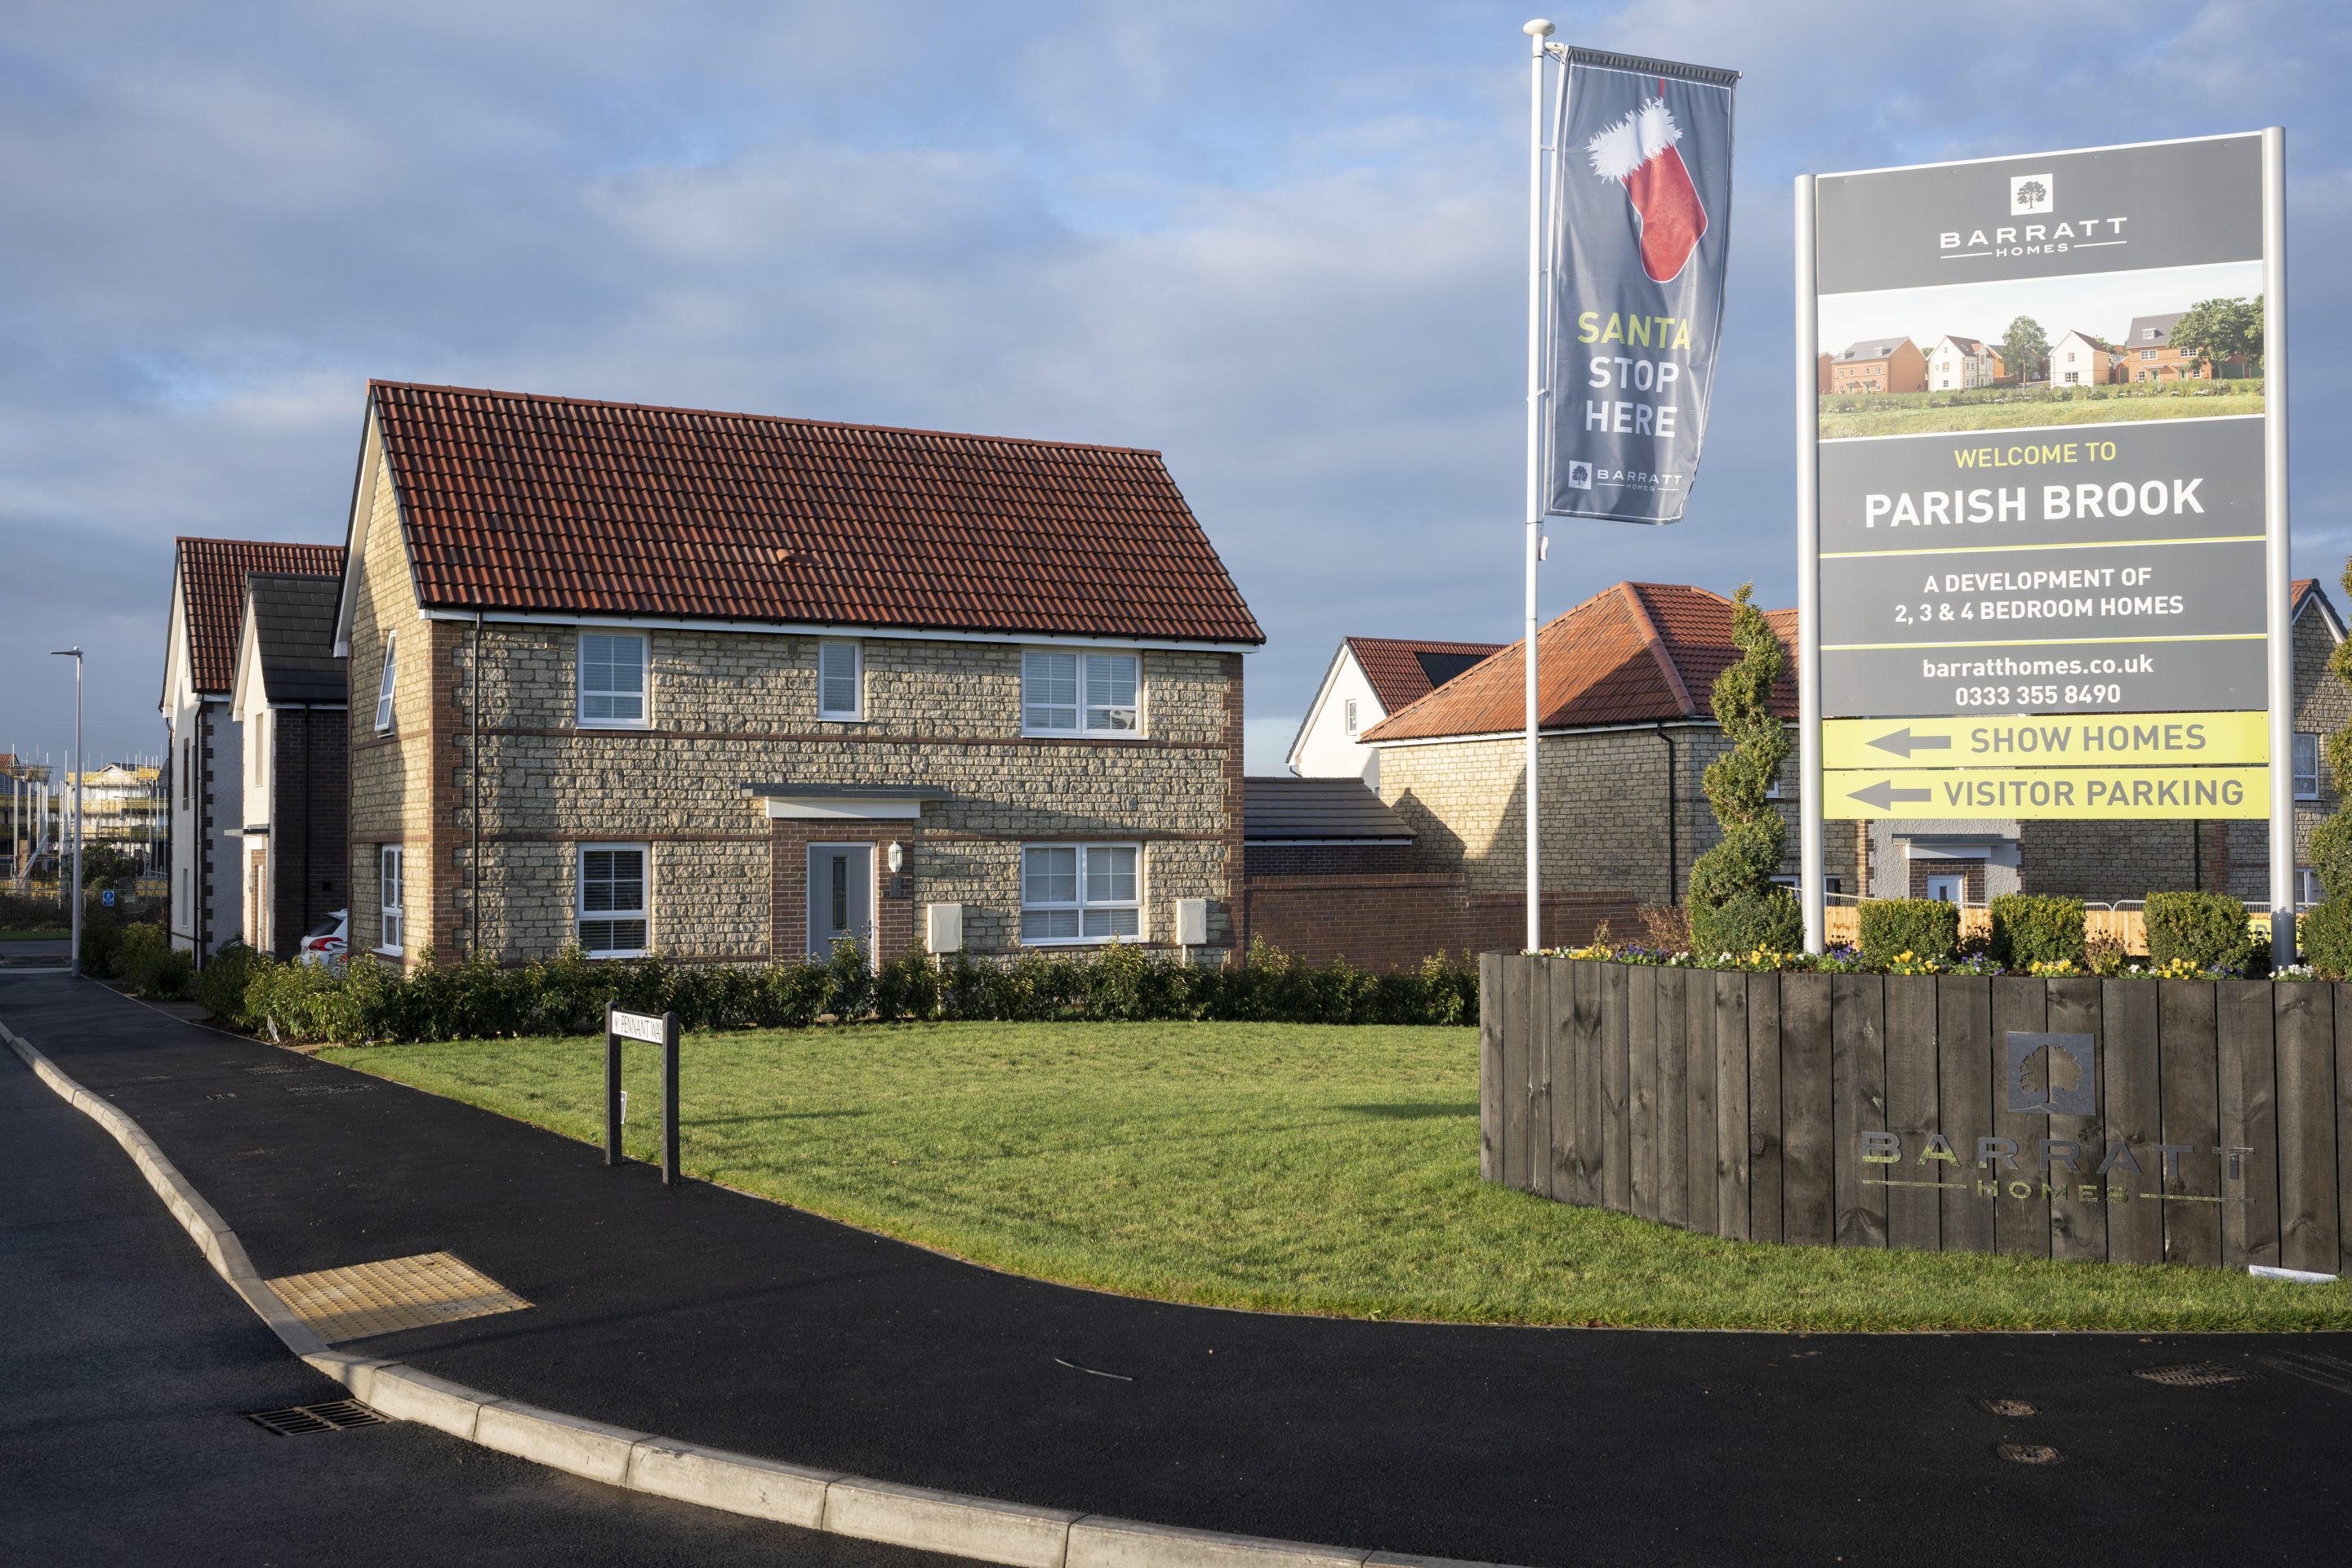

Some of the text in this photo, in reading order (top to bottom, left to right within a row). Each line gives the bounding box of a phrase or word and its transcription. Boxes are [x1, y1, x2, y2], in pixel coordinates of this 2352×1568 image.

[1940, 216, 2127, 249] BARRATT
[1996, 243, 2069, 258] HOMES
[1577, 312, 1690, 350] SANTA
[1588, 356, 1679, 392] STOP
[1586, 400, 1677, 437] HERE
[1954, 441, 2116, 469] WELCOME TO
[1597, 470, 1682, 485] BARRATT
[1626, 483, 1655, 492] HOMES
[1865, 478, 2205, 528] PARISH BROOK
[1923, 568, 2152, 593] A DEVELOPMENT OF
[1895, 595, 2184, 626] 2, 3 & 4 BEDROOM HOMES
[1923, 653, 2154, 678] barratthomes.co.uk
[1955, 684, 2121, 706] 0333 355 8490
[1971, 724, 2206, 753] SHOW HOMES
[1944, 779, 2244, 807] VISITOR PARKING
[621, 1015, 650, 1038] PENNANT
[1862, 1131, 2256, 1181] BARRATT
[1977, 1179, 2130, 1203] HOMES
